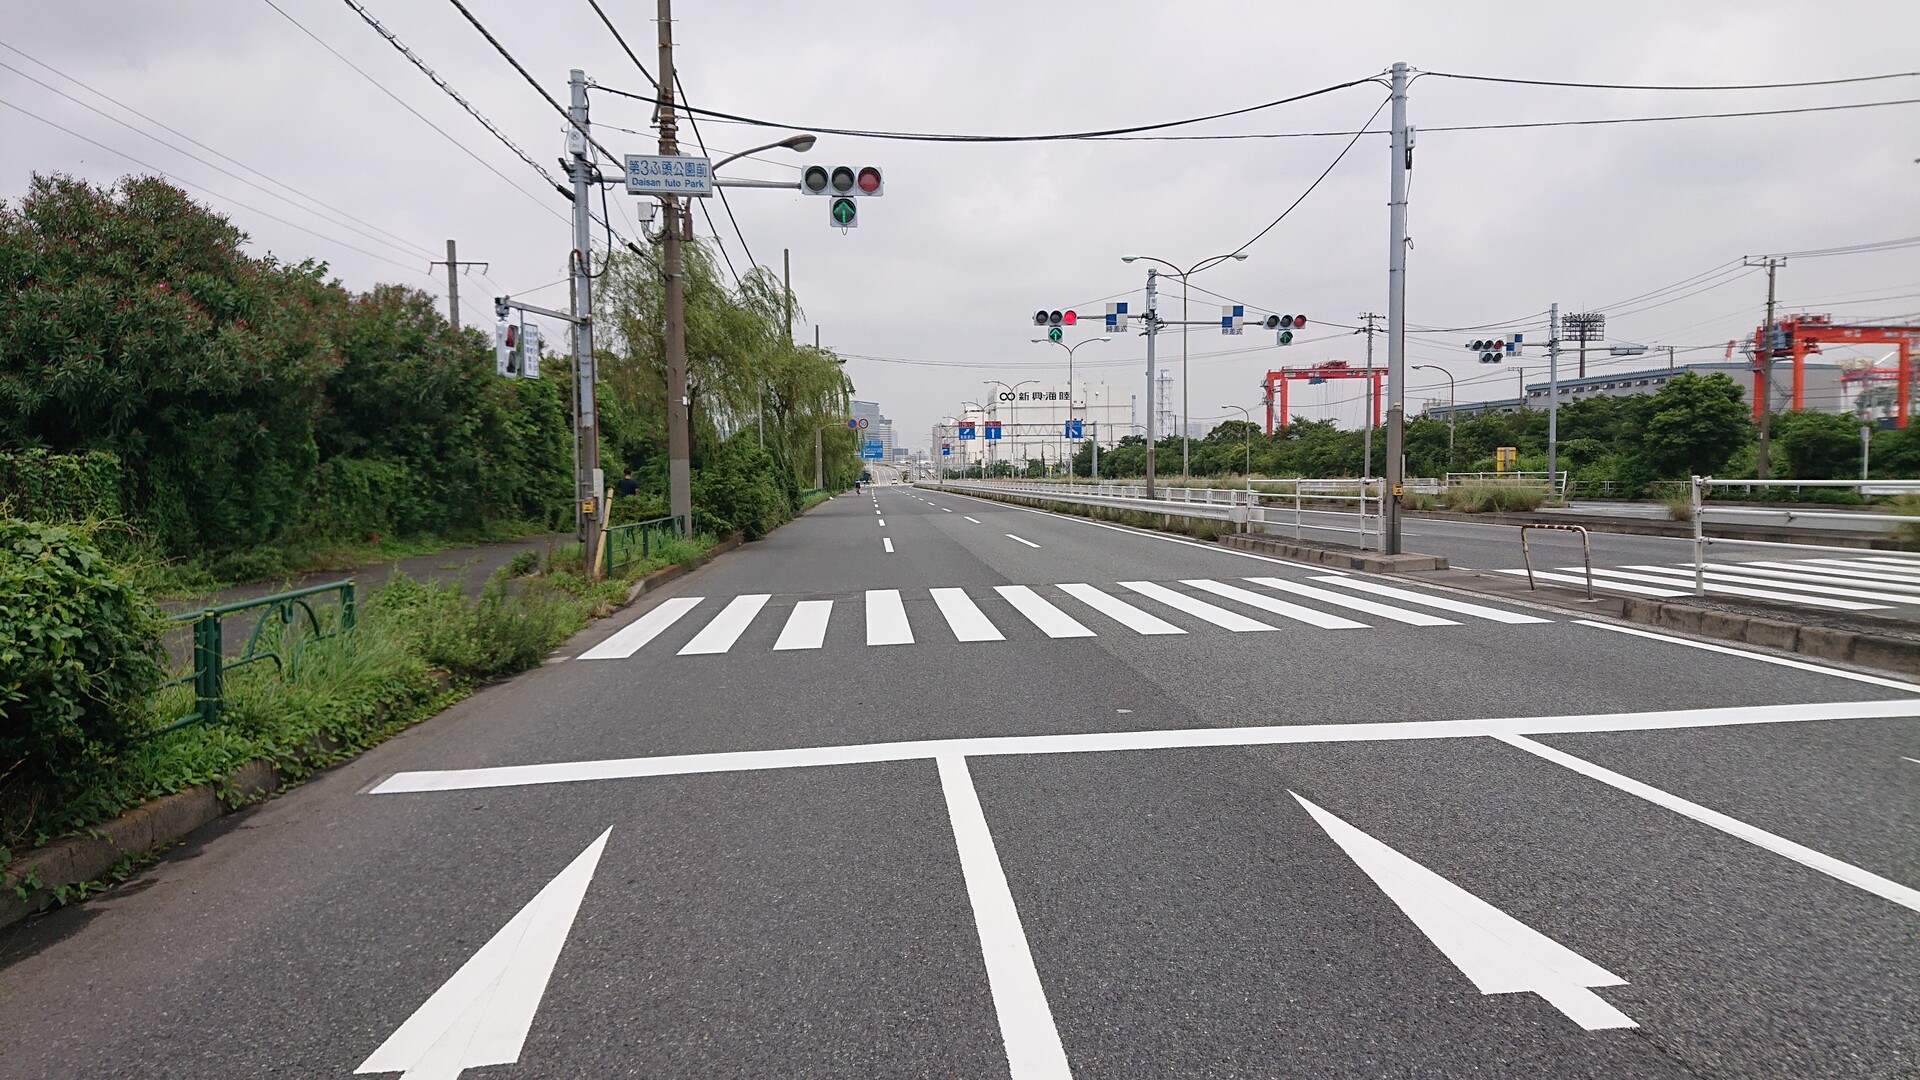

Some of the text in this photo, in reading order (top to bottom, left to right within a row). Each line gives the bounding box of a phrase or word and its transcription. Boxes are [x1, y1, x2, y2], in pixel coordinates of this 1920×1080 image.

[629, 159, 708, 178] 第3ふ頭公園前
[632, 177, 705, 188] Daisan futo Park
